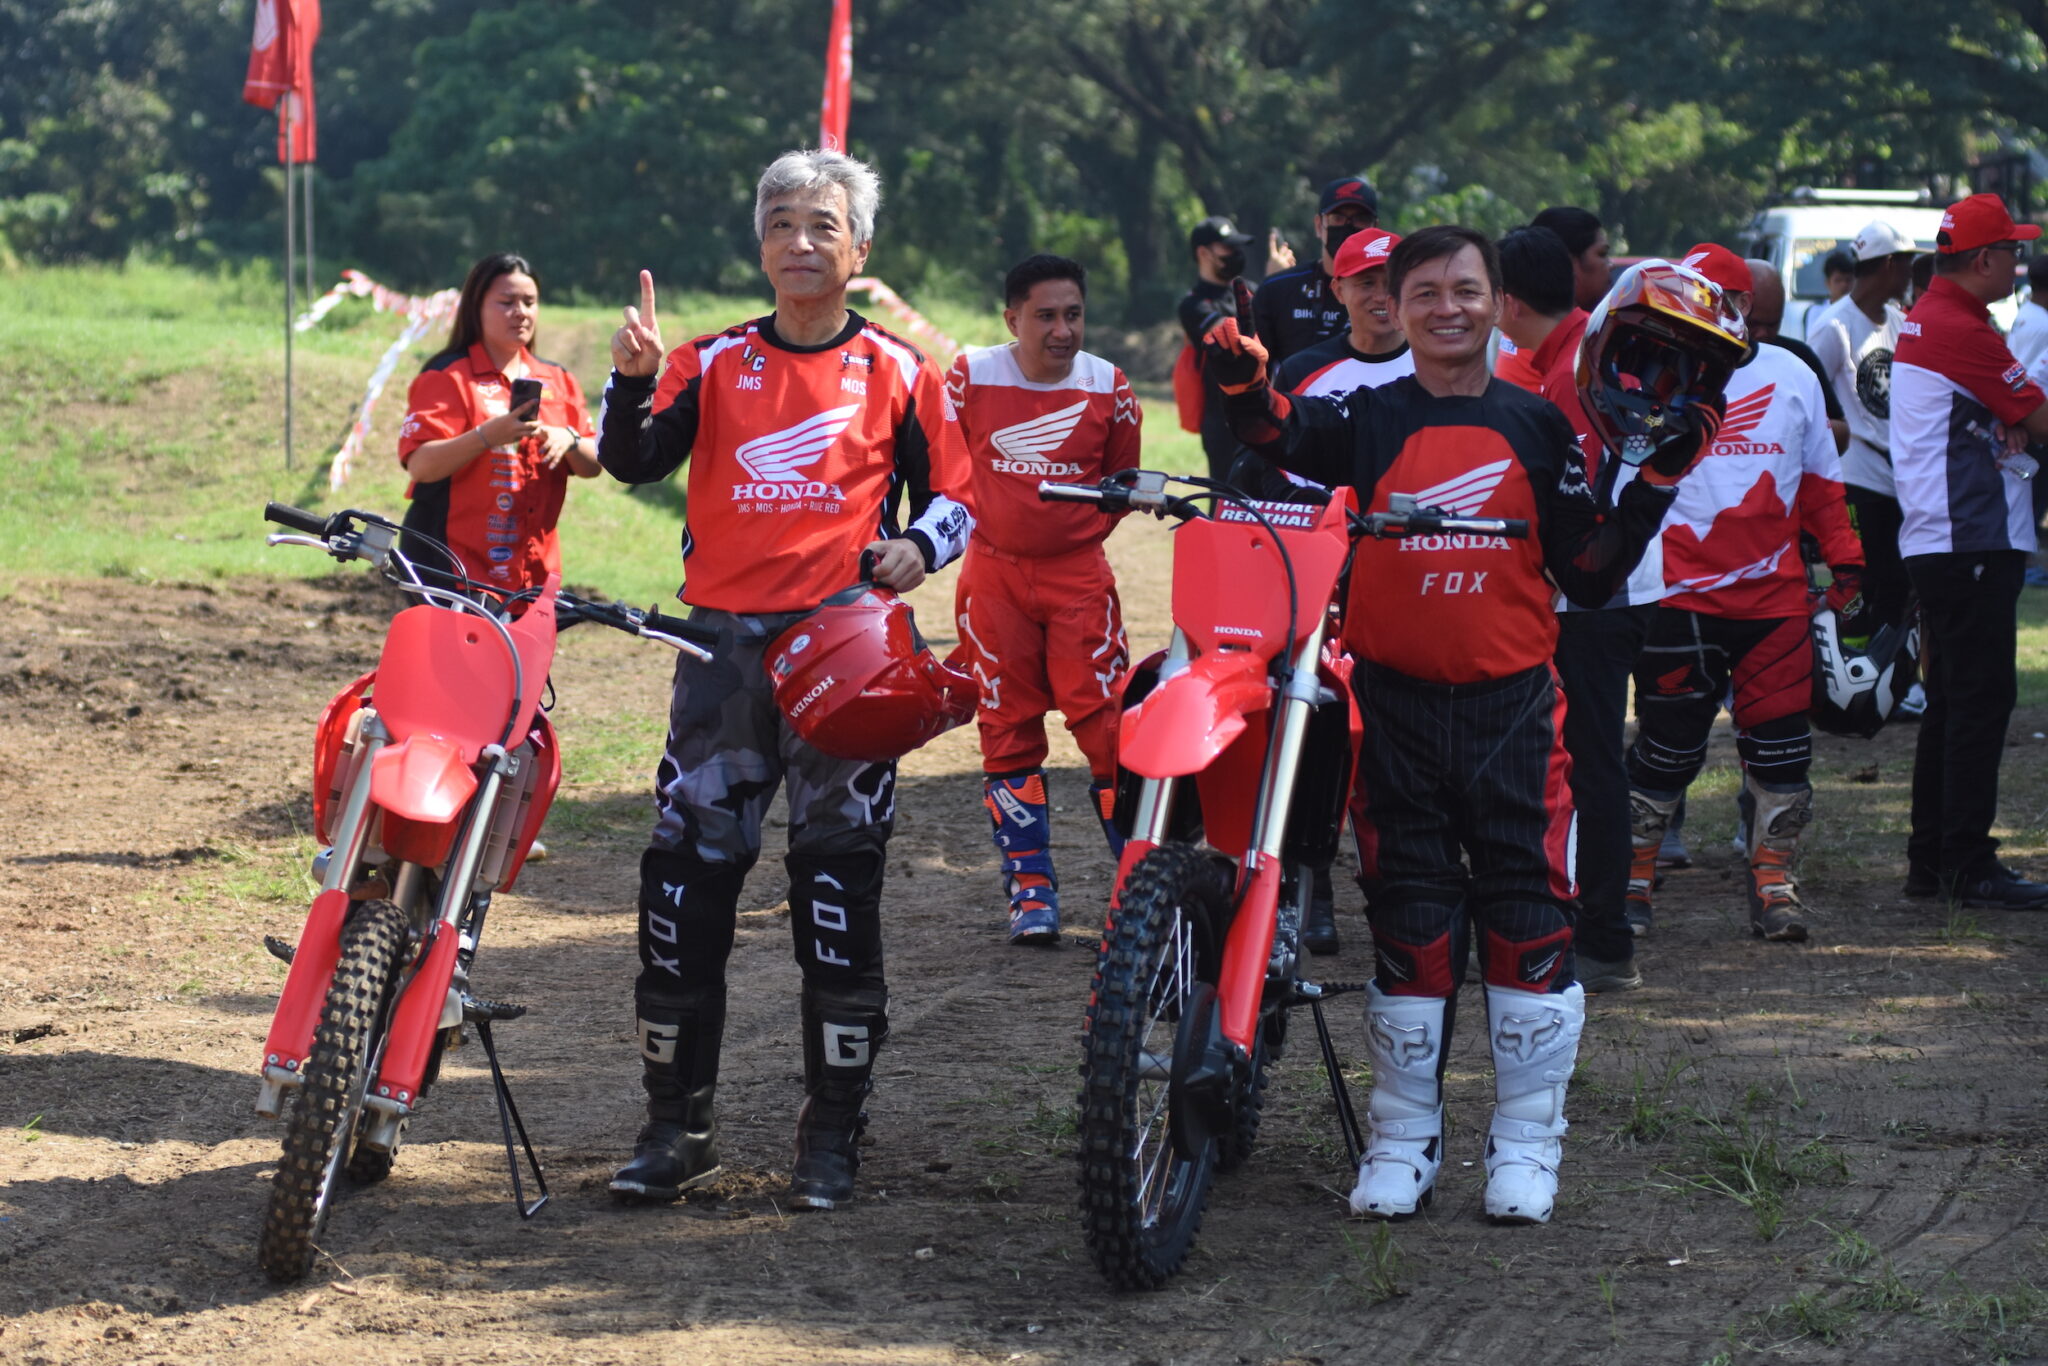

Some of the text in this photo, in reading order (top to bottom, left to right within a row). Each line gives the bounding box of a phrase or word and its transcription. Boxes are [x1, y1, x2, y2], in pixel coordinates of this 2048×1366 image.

[736, 374, 762, 390] JMS
[841, 377, 867, 395] MOS
[991, 459, 1084, 476] HONDA
[731, 481, 847, 500] HONDA
[756, 502, 773, 513] MOS
[824, 503, 840, 514] RED
[1399, 533, 1511, 551] HONDA
[1421, 571, 1488, 595] FOX
[1213, 626, 1263, 638] HONDA
[790, 674, 836, 719] HONDA
